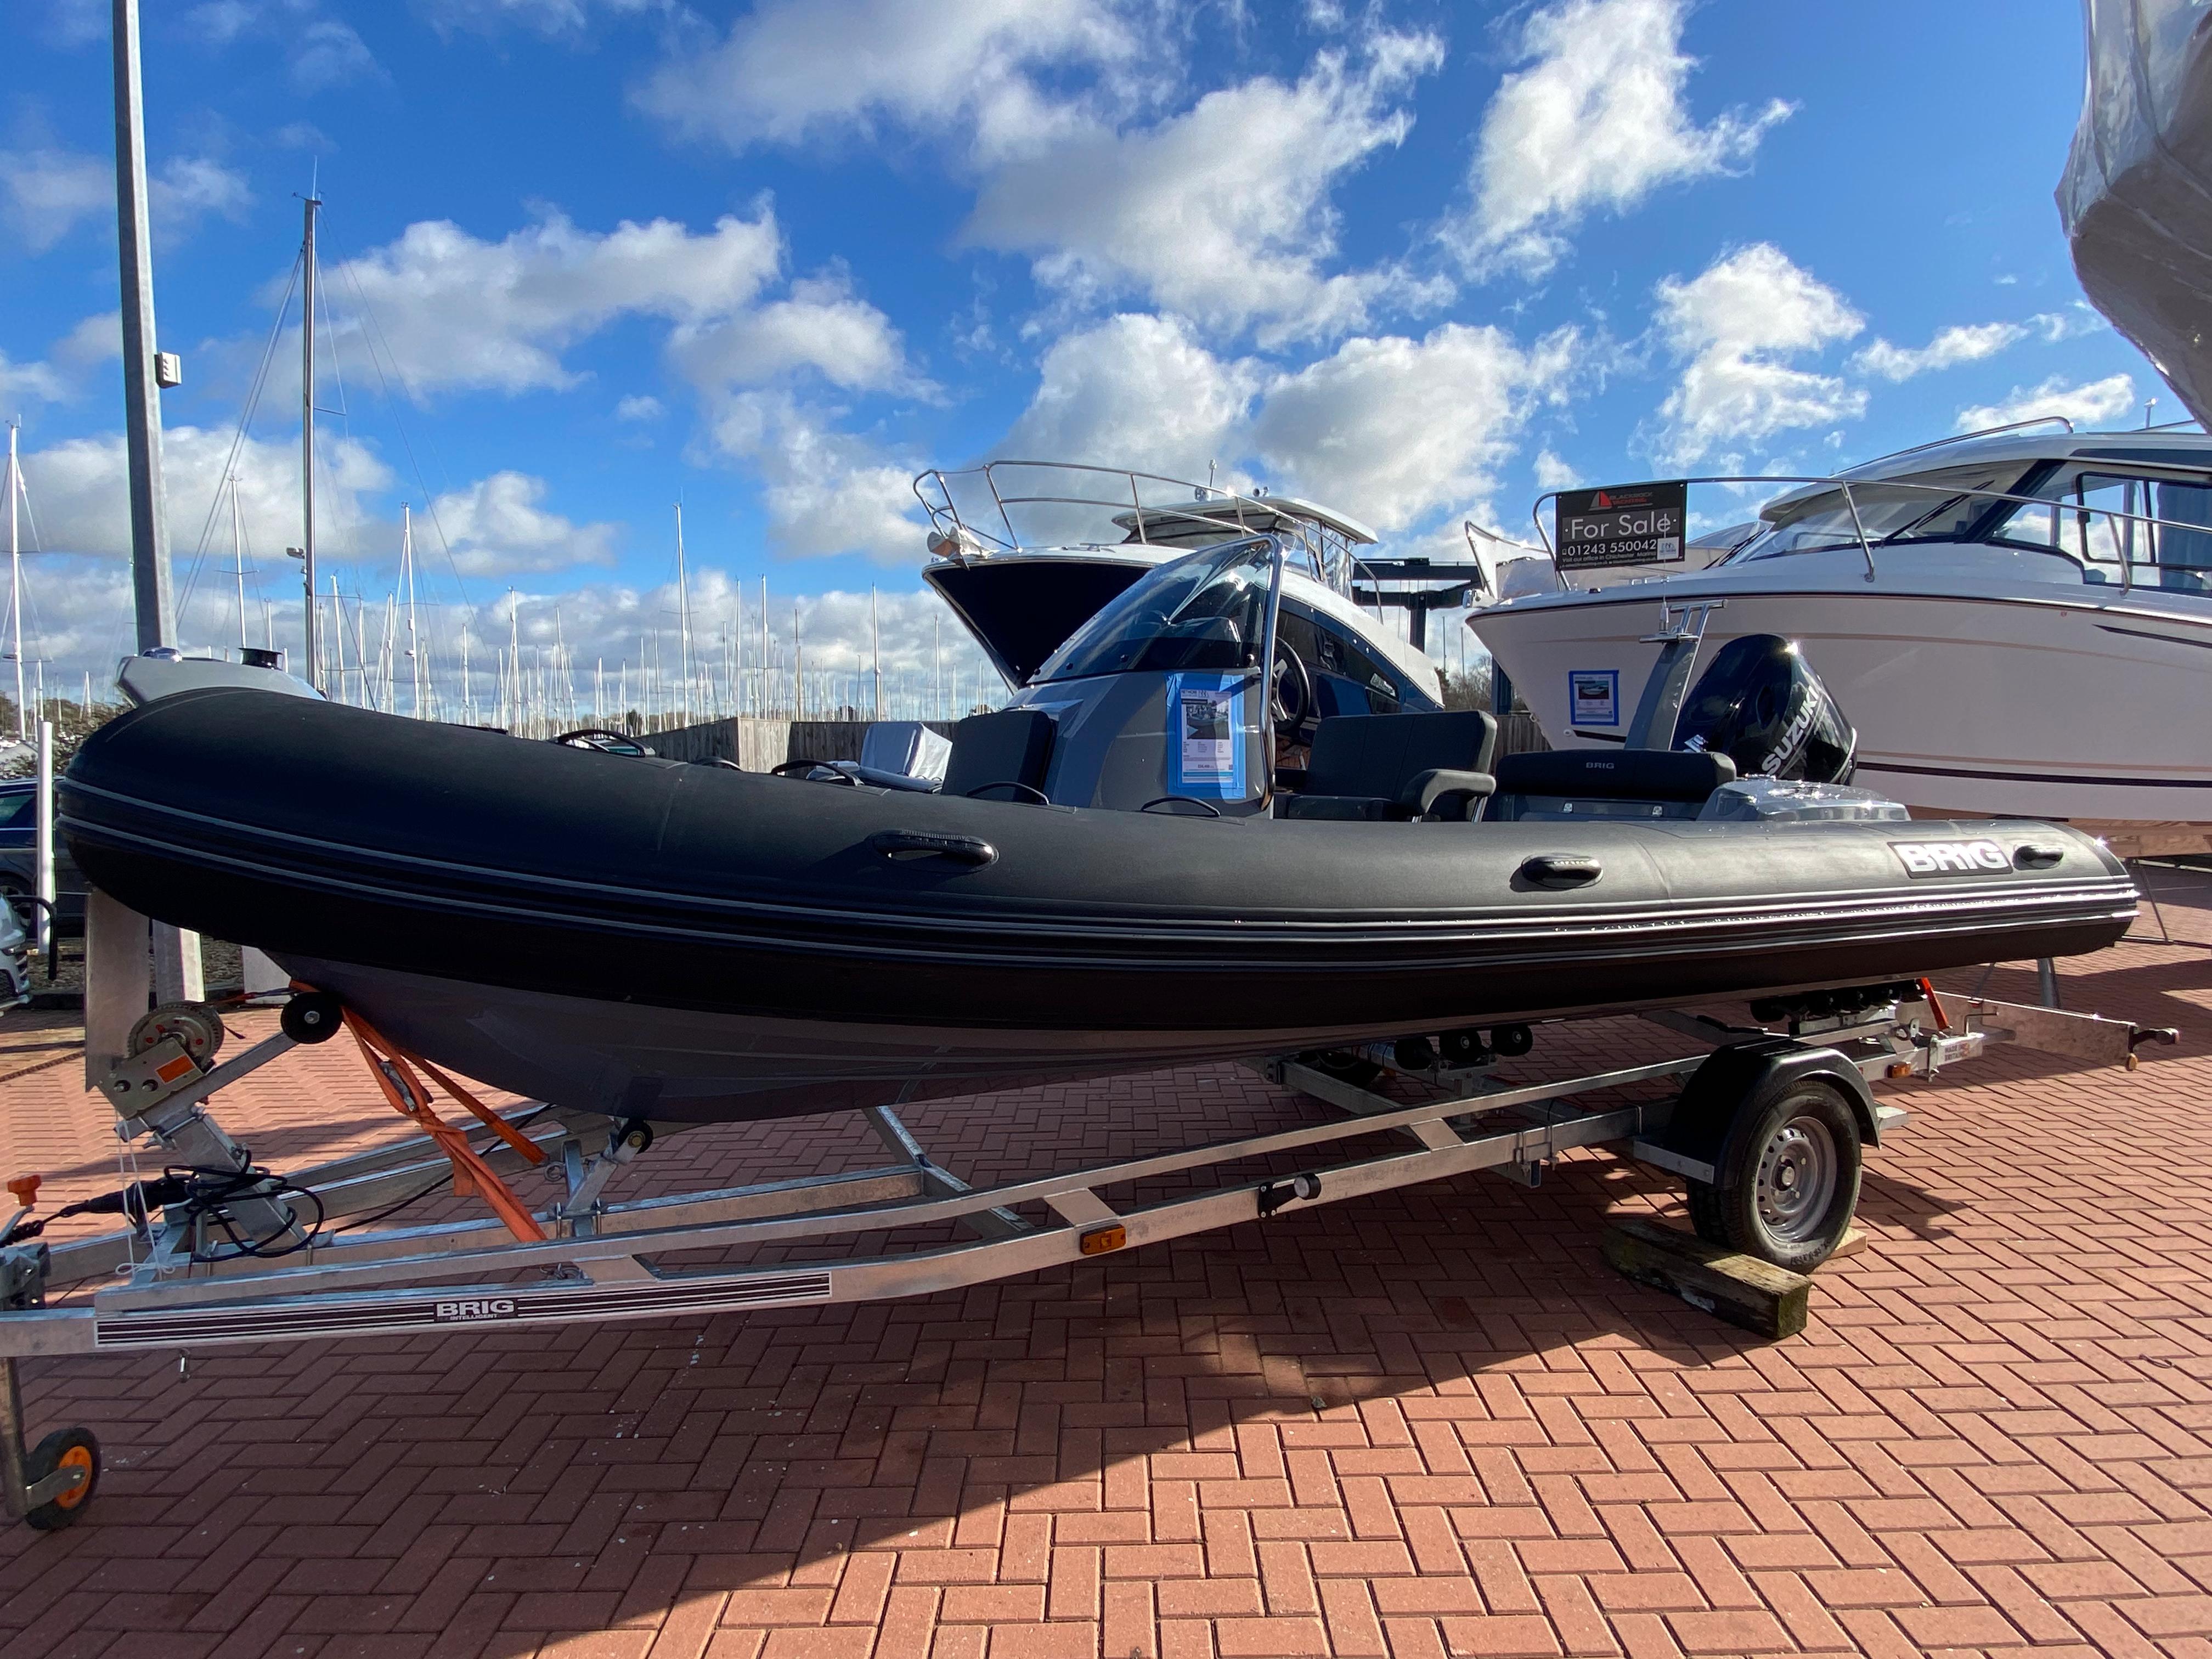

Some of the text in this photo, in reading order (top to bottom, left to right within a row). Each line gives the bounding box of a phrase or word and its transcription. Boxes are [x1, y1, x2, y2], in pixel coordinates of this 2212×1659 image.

[1571, 511, 1672, 539] For Sale
[1567, 544, 1606, 556] 01243
[1610, 539, 1657, 552] 550042
[1762, 686, 1819, 775] SUZUKI
[1894, 842, 2008, 872] BRIG
[436, 1300, 514, 1317] BRIG
